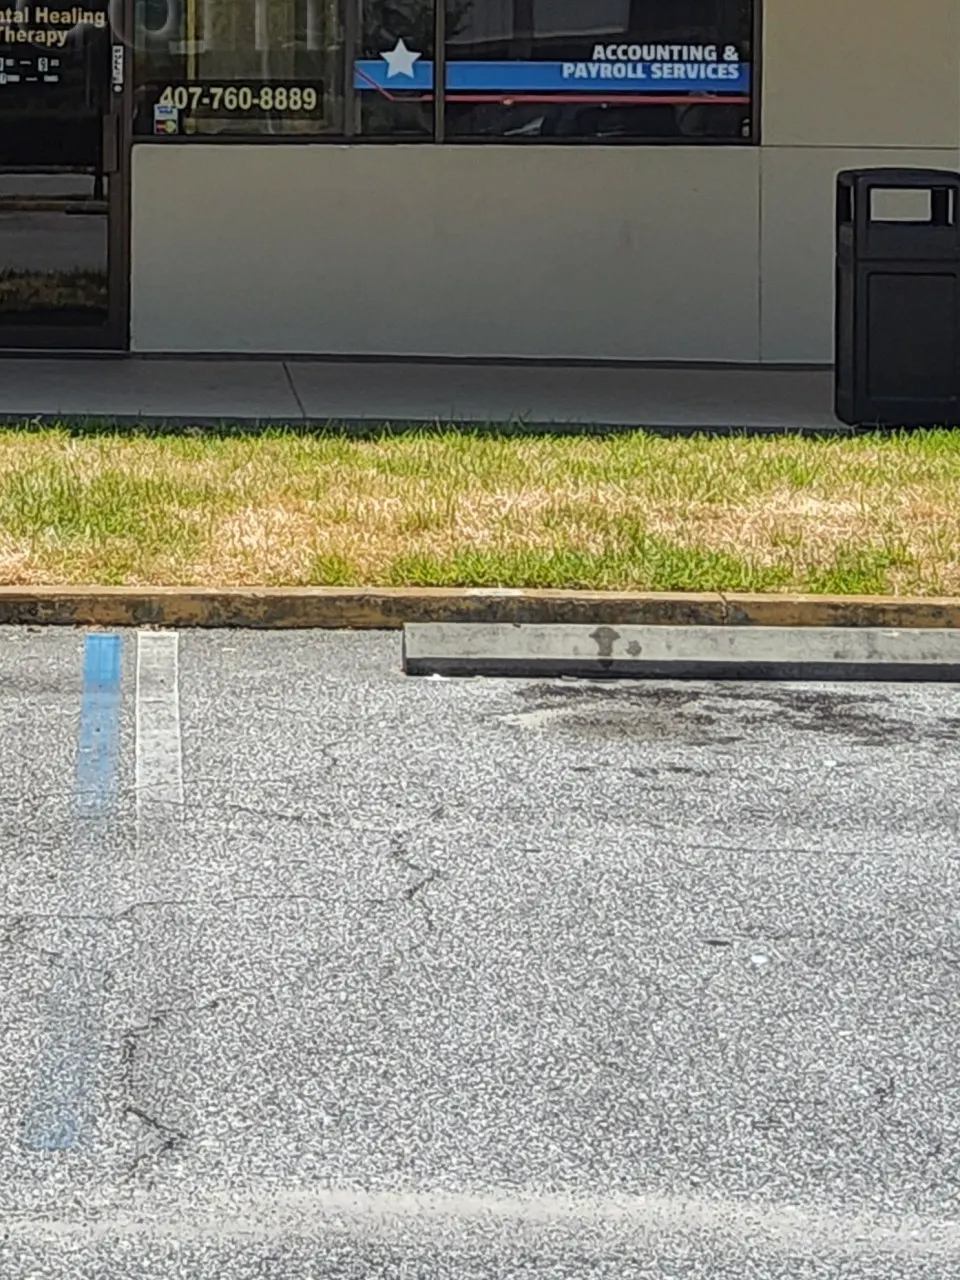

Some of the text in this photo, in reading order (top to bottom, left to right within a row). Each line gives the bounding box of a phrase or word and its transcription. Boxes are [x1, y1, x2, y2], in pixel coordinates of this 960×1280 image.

[34, 6, 106, 28] Healing
[592, 44, 740, 61] ACCOUNTING &
[561, 62, 740, 80] PAYROLL SERVICES
[159, 86, 318, 110] 407-760-8889
